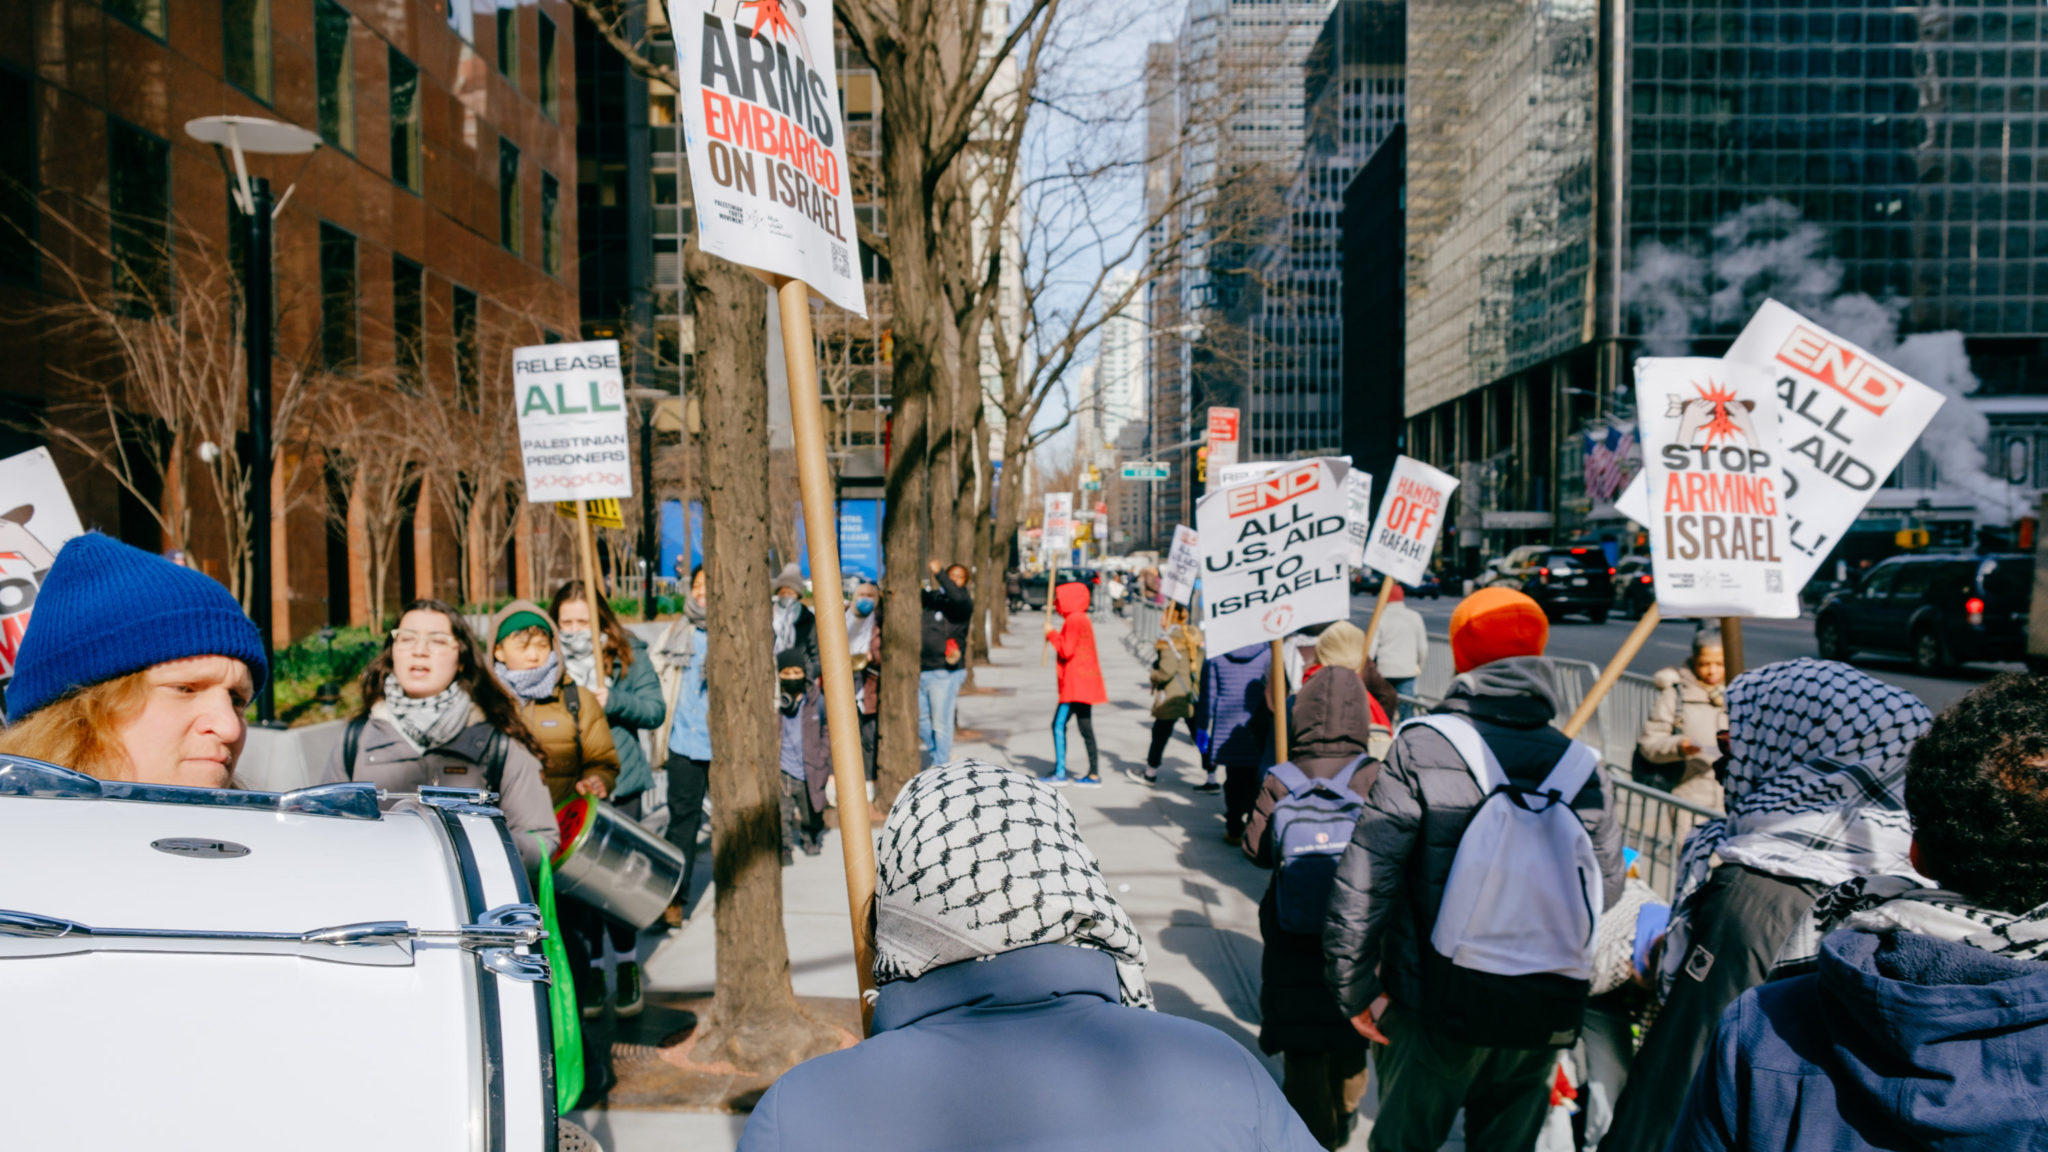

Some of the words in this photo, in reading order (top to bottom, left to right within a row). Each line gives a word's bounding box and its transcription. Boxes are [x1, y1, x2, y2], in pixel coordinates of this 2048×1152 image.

[701, 11, 834, 148] ARMS
[702, 88, 839, 197] EMBARGO
[707, 140, 757, 197] ON
[765, 157, 847, 243] ISRAEL
[714, 199, 743, 212] PALESTINIAN
[718, 212, 744, 225] MOVEMENT
[728, 209, 744, 218] YOUTH
[516, 355, 618, 374] RELEASE
[1779, 326, 1901, 410] END
[521, 381, 621, 417] ALL
[1777, 376, 1852, 445] ALL
[523, 435, 624, 450] PALESTINIAN
[527, 451, 625, 466] PRISONERS
[1661, 443, 1771, 473] STOP
[1788, 435, 1877, 492] AID
[1229, 465, 1319, 515] END
[1396, 476, 1442, 509] HANDS
[1664, 472, 1778, 517] ARMING
[1237, 503, 1313, 543] ALL
[1387, 496, 1437, 540] OFF
[1665, 514, 1782, 563] ISRAEL
[1206, 542, 1275, 572] U.S.
[1283, 516, 1345, 551] AID
[1379, 529, 1426, 560] RAFAH!
[1211, 564, 1341, 618] ISRAEL!
[1248, 555, 1303, 586] TO
